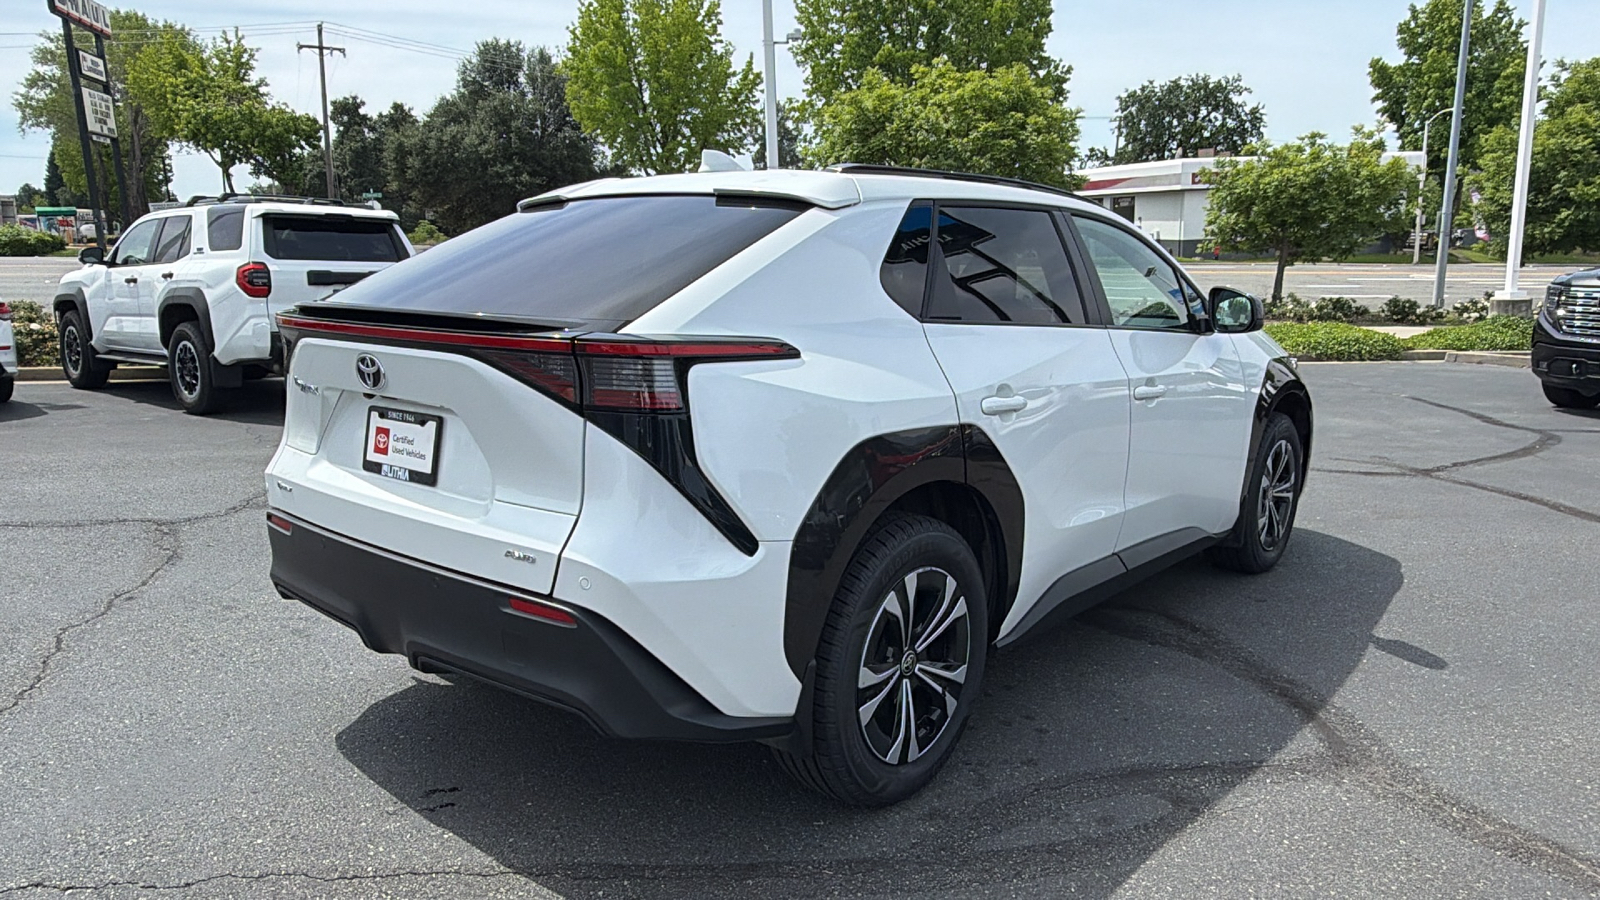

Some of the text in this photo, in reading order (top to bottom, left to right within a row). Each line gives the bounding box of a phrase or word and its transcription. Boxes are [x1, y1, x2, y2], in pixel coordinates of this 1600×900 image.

[388, 411, 415, 422] SINCE 1946
[392, 434, 415, 446] Certified
[392, 446, 426, 460] Used Vehicles
[387, 465, 410, 481] LITHIA
